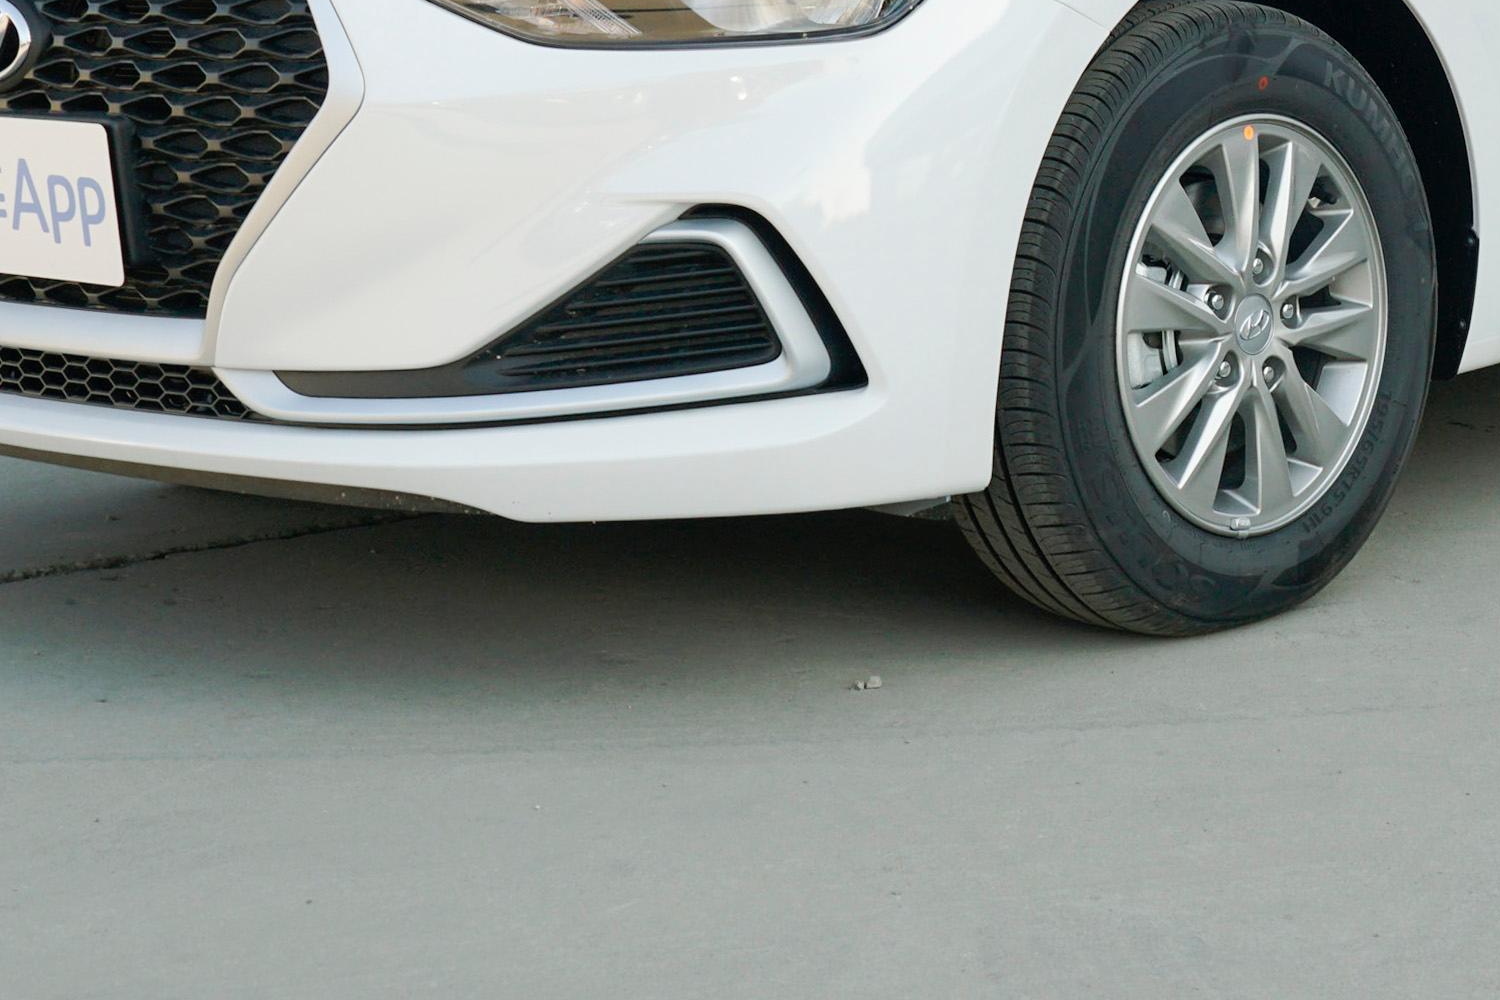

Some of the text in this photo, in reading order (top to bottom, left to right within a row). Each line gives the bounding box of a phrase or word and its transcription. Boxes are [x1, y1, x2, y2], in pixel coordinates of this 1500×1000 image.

[1323, 59, 1418, 197] KUMHO
[0, 158, 106, 247] App
[1329, 390, 1392, 508] 195/65R15
